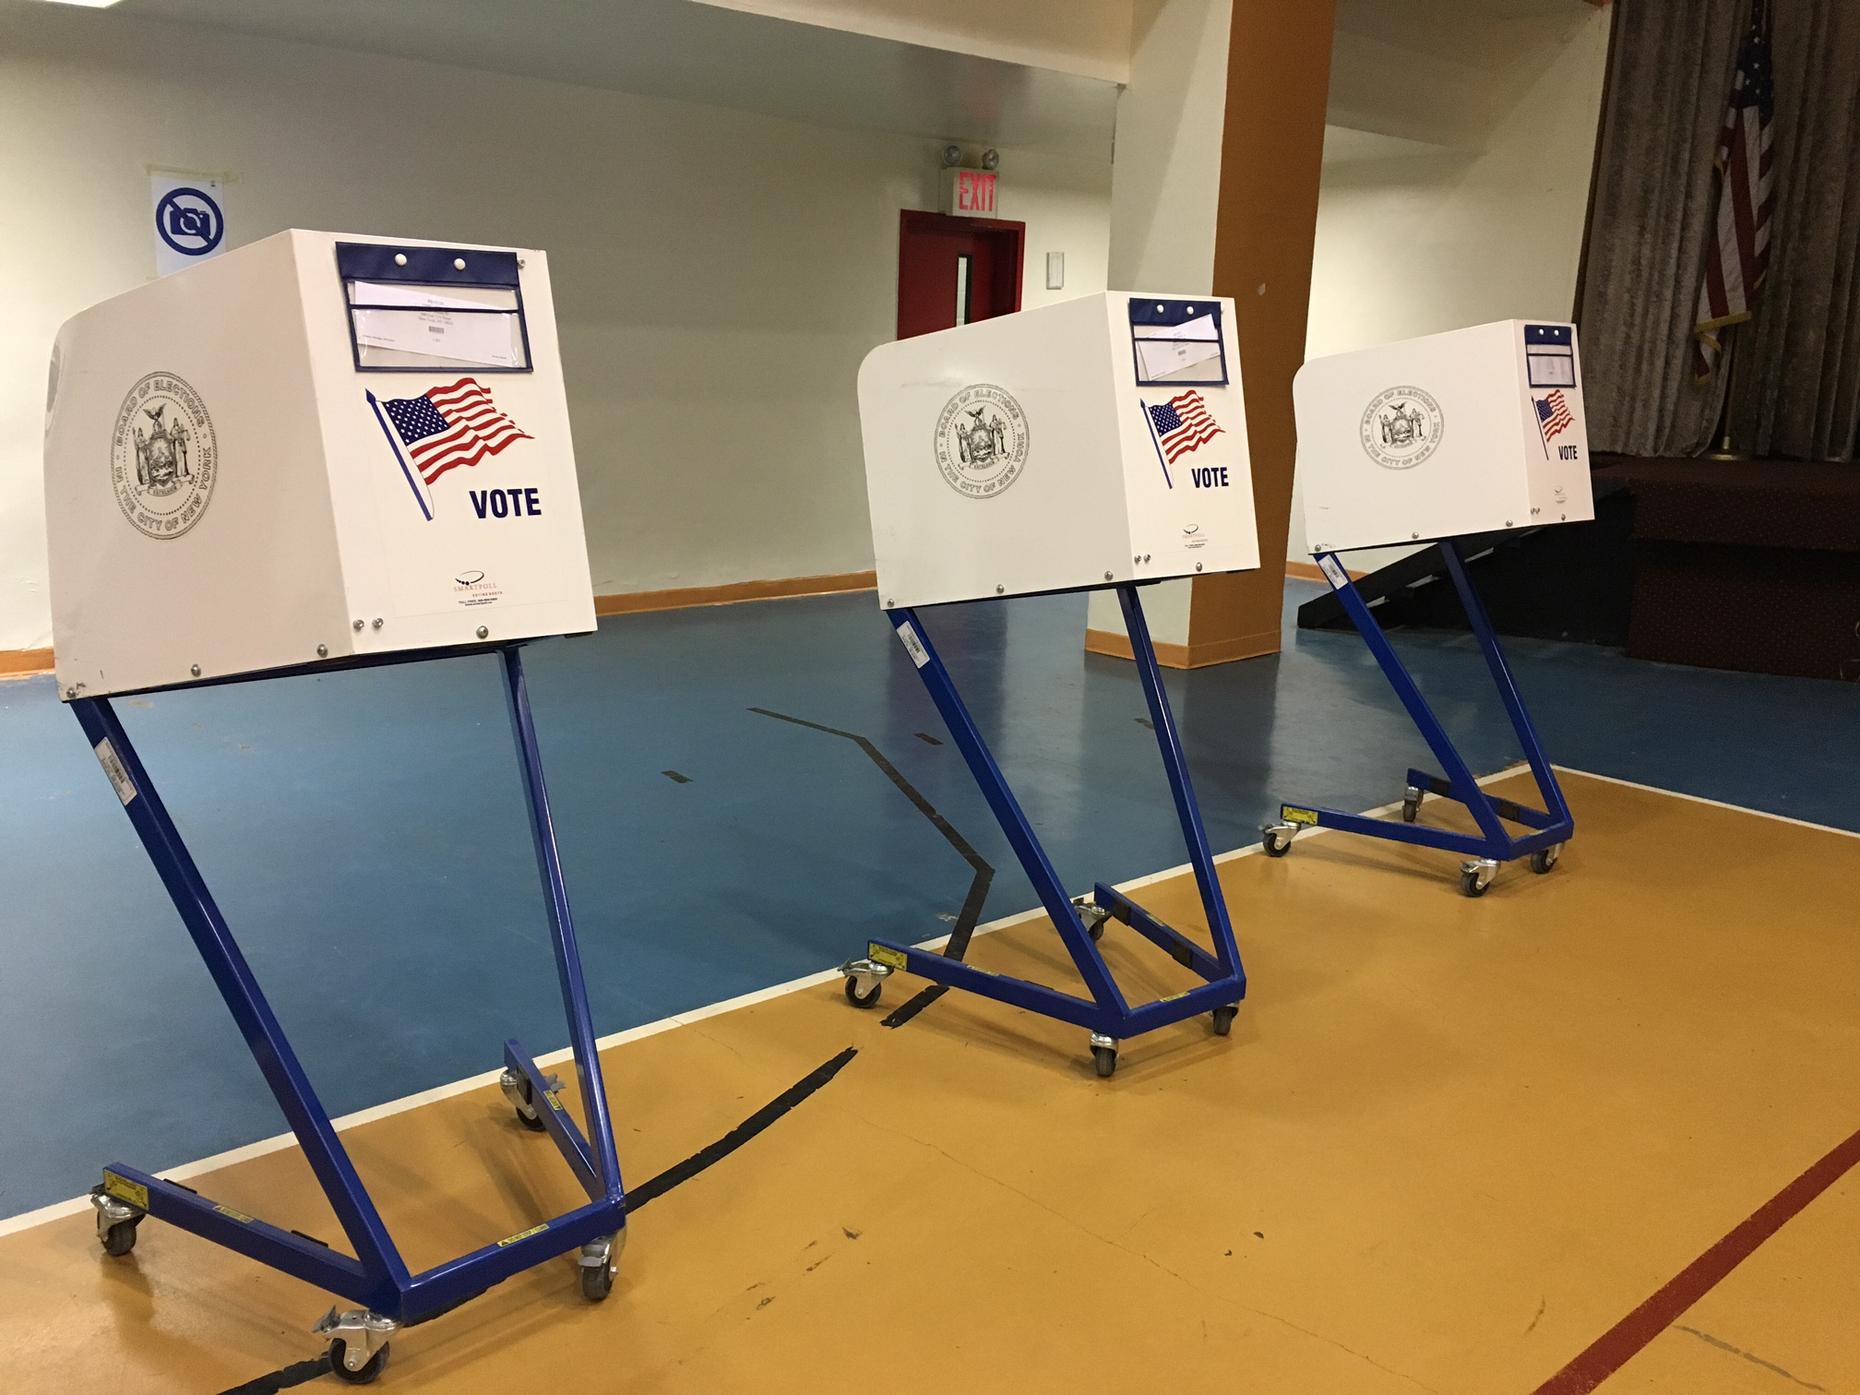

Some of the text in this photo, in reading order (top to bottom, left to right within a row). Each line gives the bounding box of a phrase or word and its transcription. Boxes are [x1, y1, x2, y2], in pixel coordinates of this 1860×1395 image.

[959, 171, 996, 212] EXIT
[116, 379, 206, 447] BOARD OF ELECTIONS
[974, 389, 1019, 420] ELECTIONS
[1558, 445, 1578, 460] VOTE
[119, 486, 137, 514] THE
[137, 511, 162, 531] CITY
[165, 517, 179, 531] OF
[182, 494, 203, 524] NEW
[199, 447, 211, 491] YORK
[960, 481, 981, 493] CITY
[983, 482, 996, 493] OF
[1191, 467, 1229, 488] VOTE
[469, 488, 542, 519] VOTE
